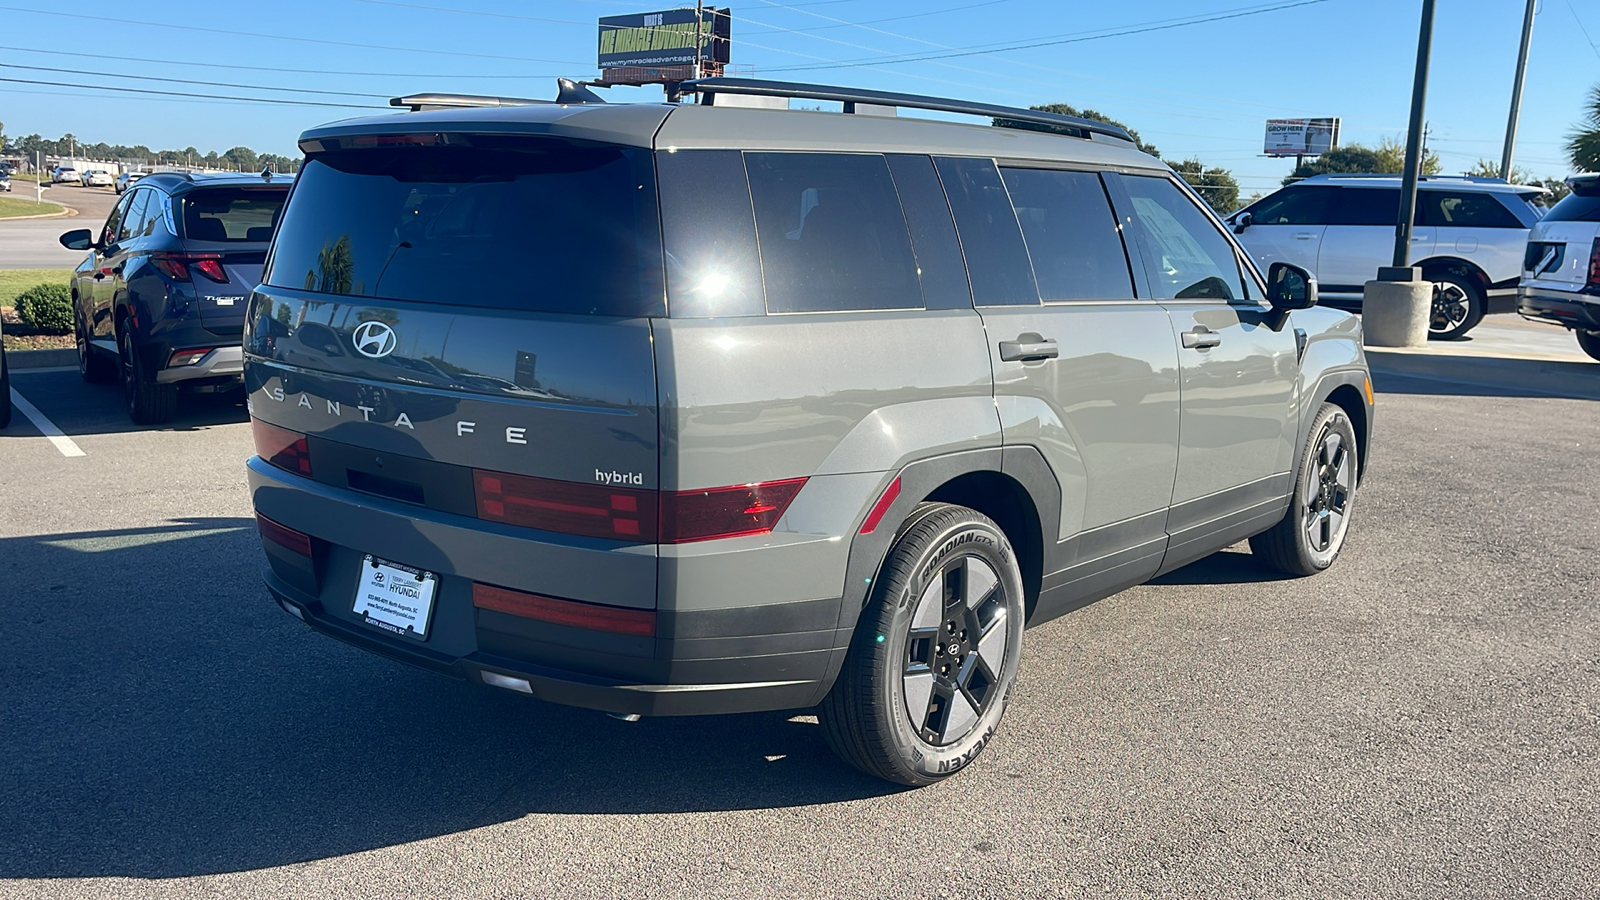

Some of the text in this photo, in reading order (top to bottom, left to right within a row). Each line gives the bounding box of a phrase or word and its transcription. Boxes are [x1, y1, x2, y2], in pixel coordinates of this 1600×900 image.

[644, 13, 663, 26] WHAT IS
[600, 29, 616, 54] THE
[614, 26, 652, 53] MIRACLE
[601, 54, 709, 67] www.mymiracleadvantage.cm
[273, 387, 415, 430] SANTA
[457, 420, 527, 445] FE
[595, 468, 643, 485] hybrid
[922, 532, 995, 583] ROADIAN GTX
[392, 575, 422, 588] TERRY LAMBERT
[389, 583, 421, 599] HYUNDAI
[365, 617, 379, 627] NORTH
[937, 724, 993, 772] NEXEN
